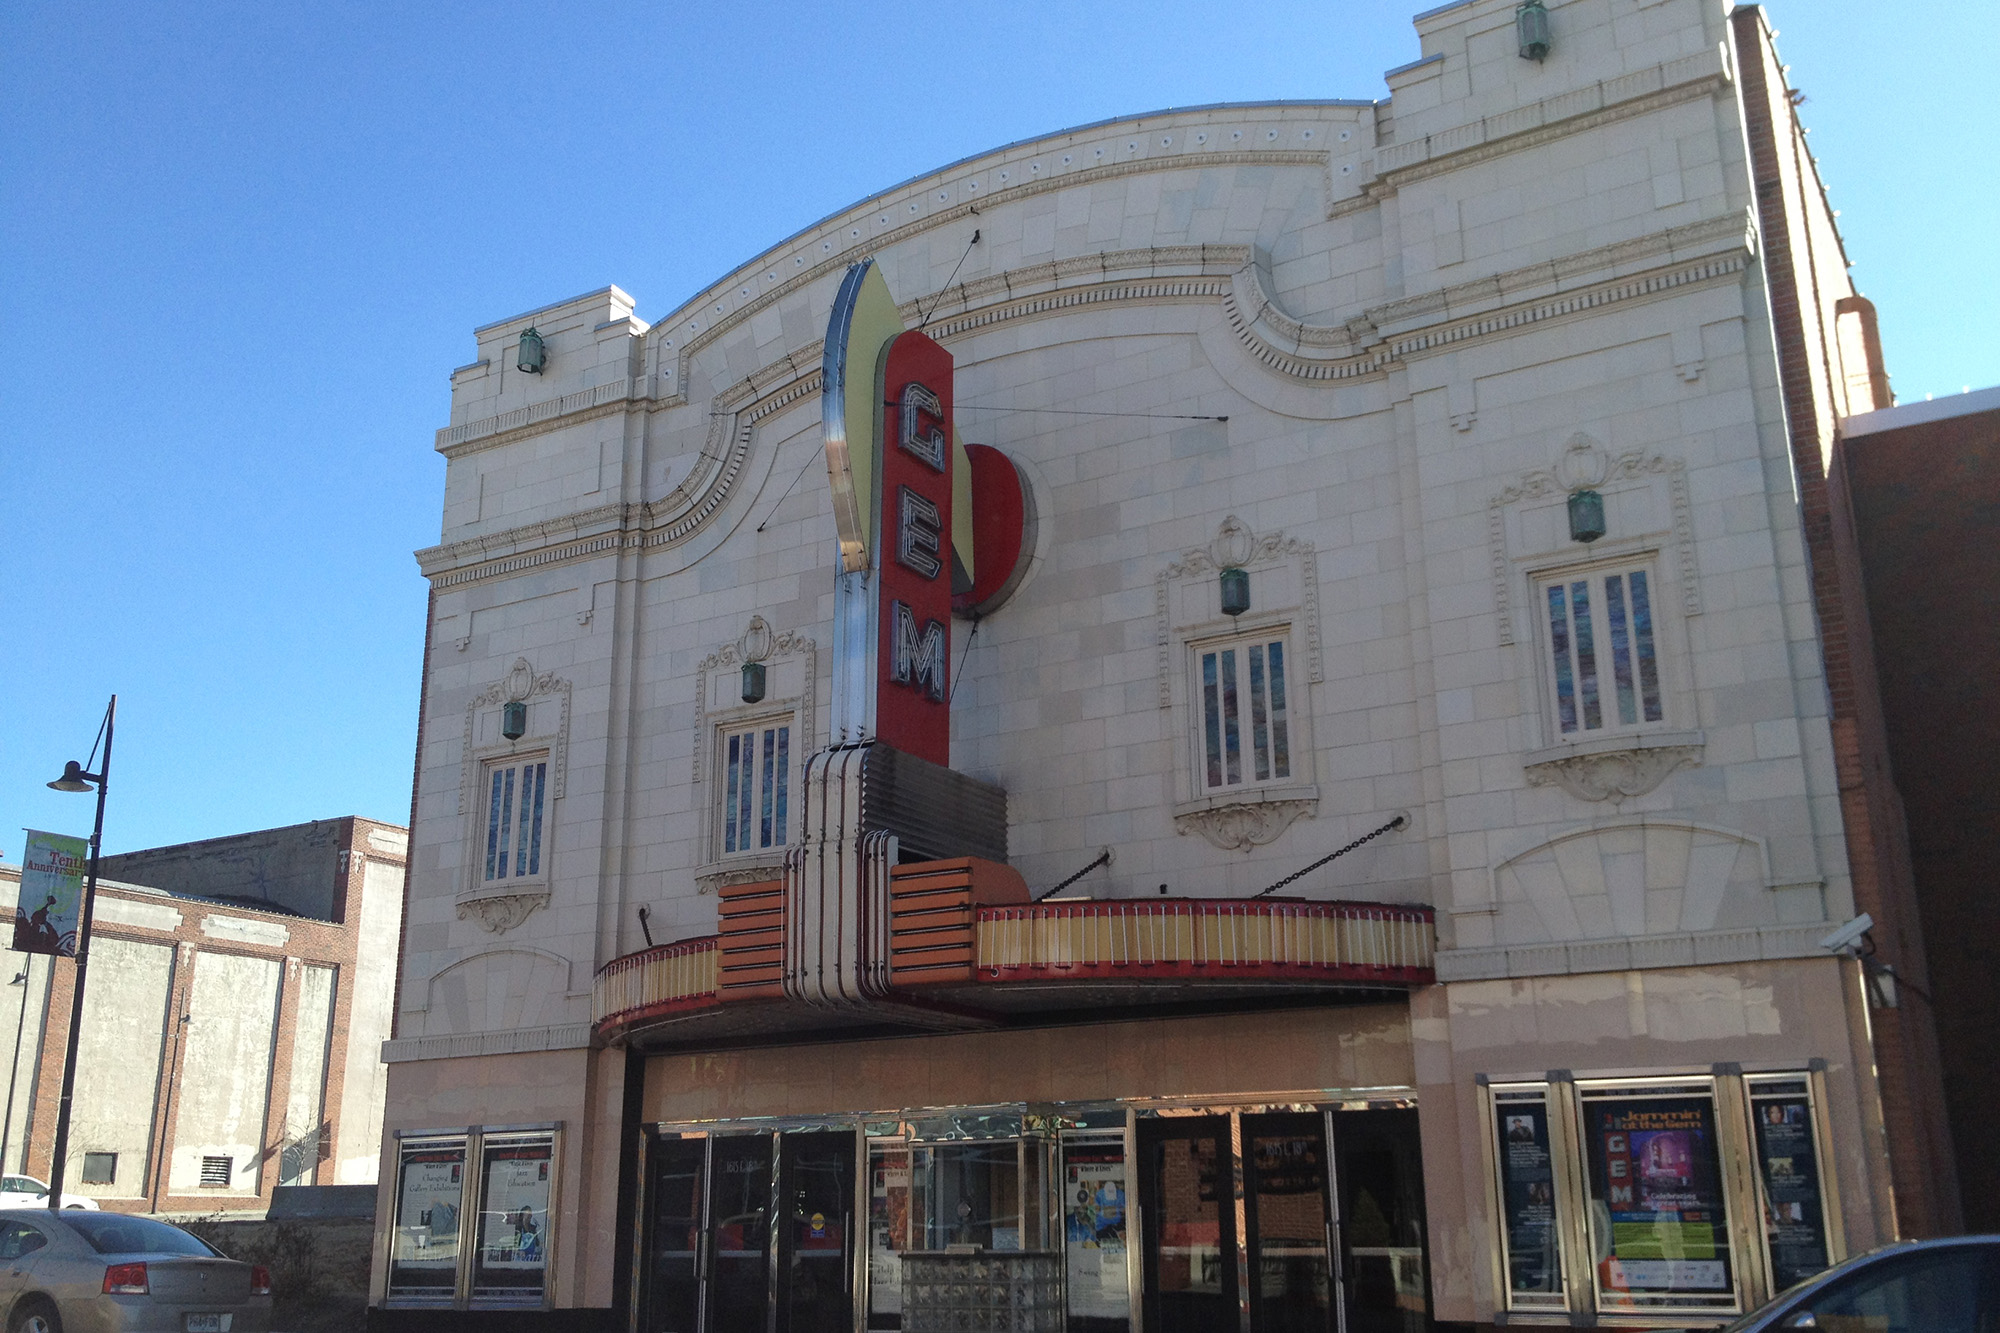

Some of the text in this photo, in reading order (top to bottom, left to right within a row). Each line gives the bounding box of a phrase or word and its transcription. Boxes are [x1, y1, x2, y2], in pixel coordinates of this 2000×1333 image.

[890, 380, 946, 705] GEM
[26, 860, 85, 879] Anniversary
[50, 852, 86, 869] Tenth
[1639, 1120, 1664, 1129] the
[1607, 1135, 1632, 1203] GEM
